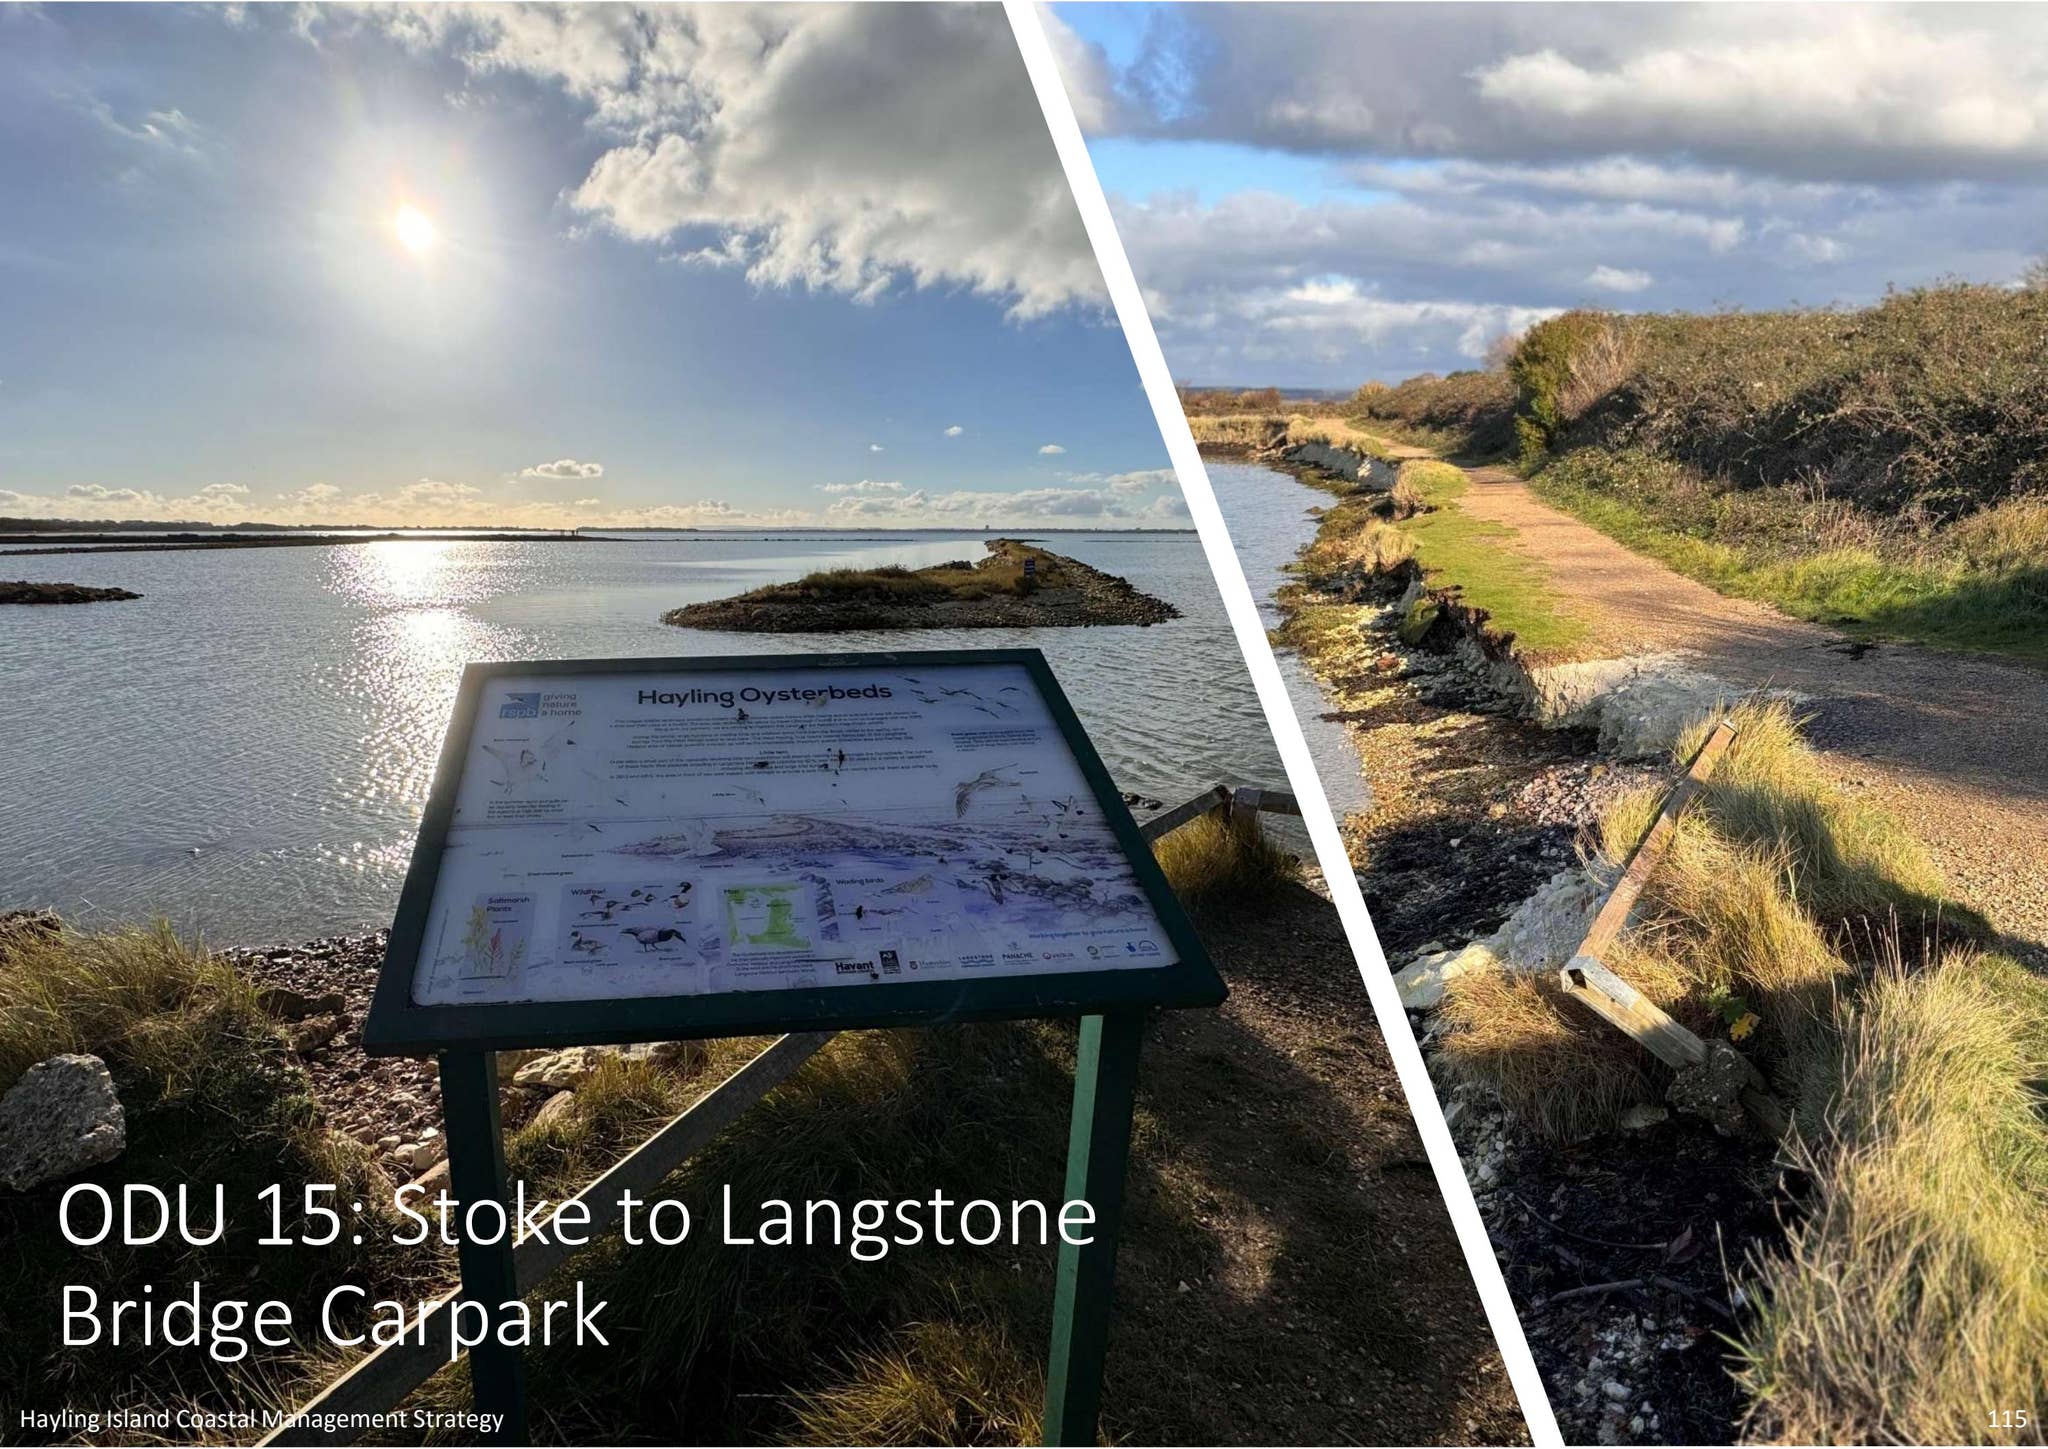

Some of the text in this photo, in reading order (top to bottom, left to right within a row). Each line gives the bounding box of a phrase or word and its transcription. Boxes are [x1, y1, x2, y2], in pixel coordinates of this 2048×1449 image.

[543, 692, 577, 702] giving
[638, 684, 893, 708] Hayling Oysterbeds
[542, 701, 578, 709] nature
[550, 708, 582, 717] home
[834, 960, 875, 971] Havant
